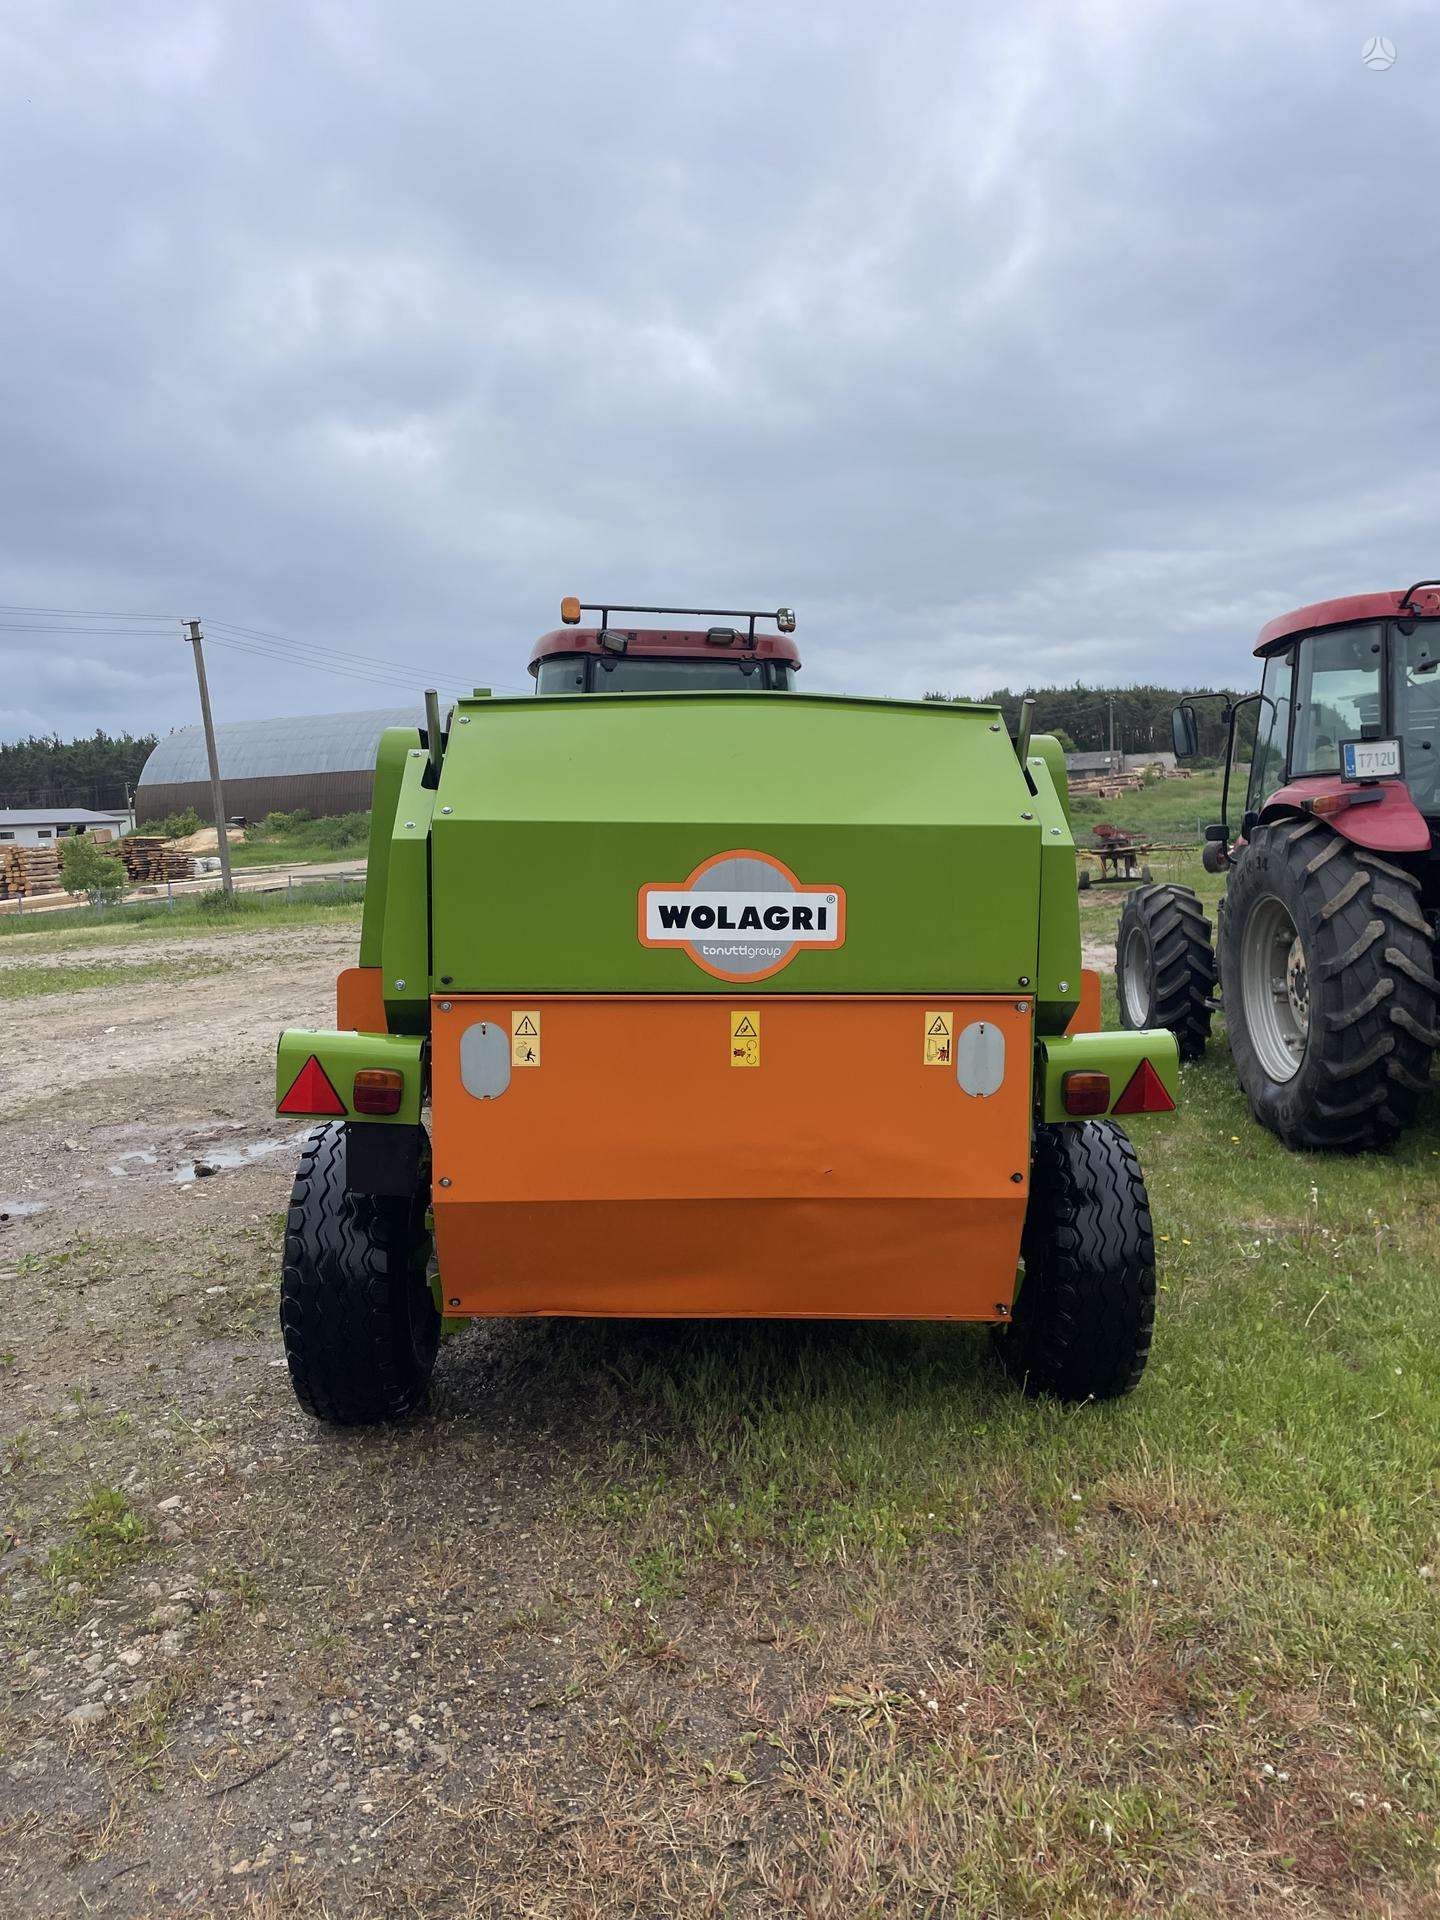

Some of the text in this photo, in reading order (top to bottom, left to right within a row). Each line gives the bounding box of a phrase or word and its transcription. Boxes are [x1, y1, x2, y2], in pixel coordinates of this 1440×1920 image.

[1359, 751, 1396, 768] T712U
[658, 905, 827, 931] WOLAGRI
[702, 945, 782, 959] tonuttigroup
